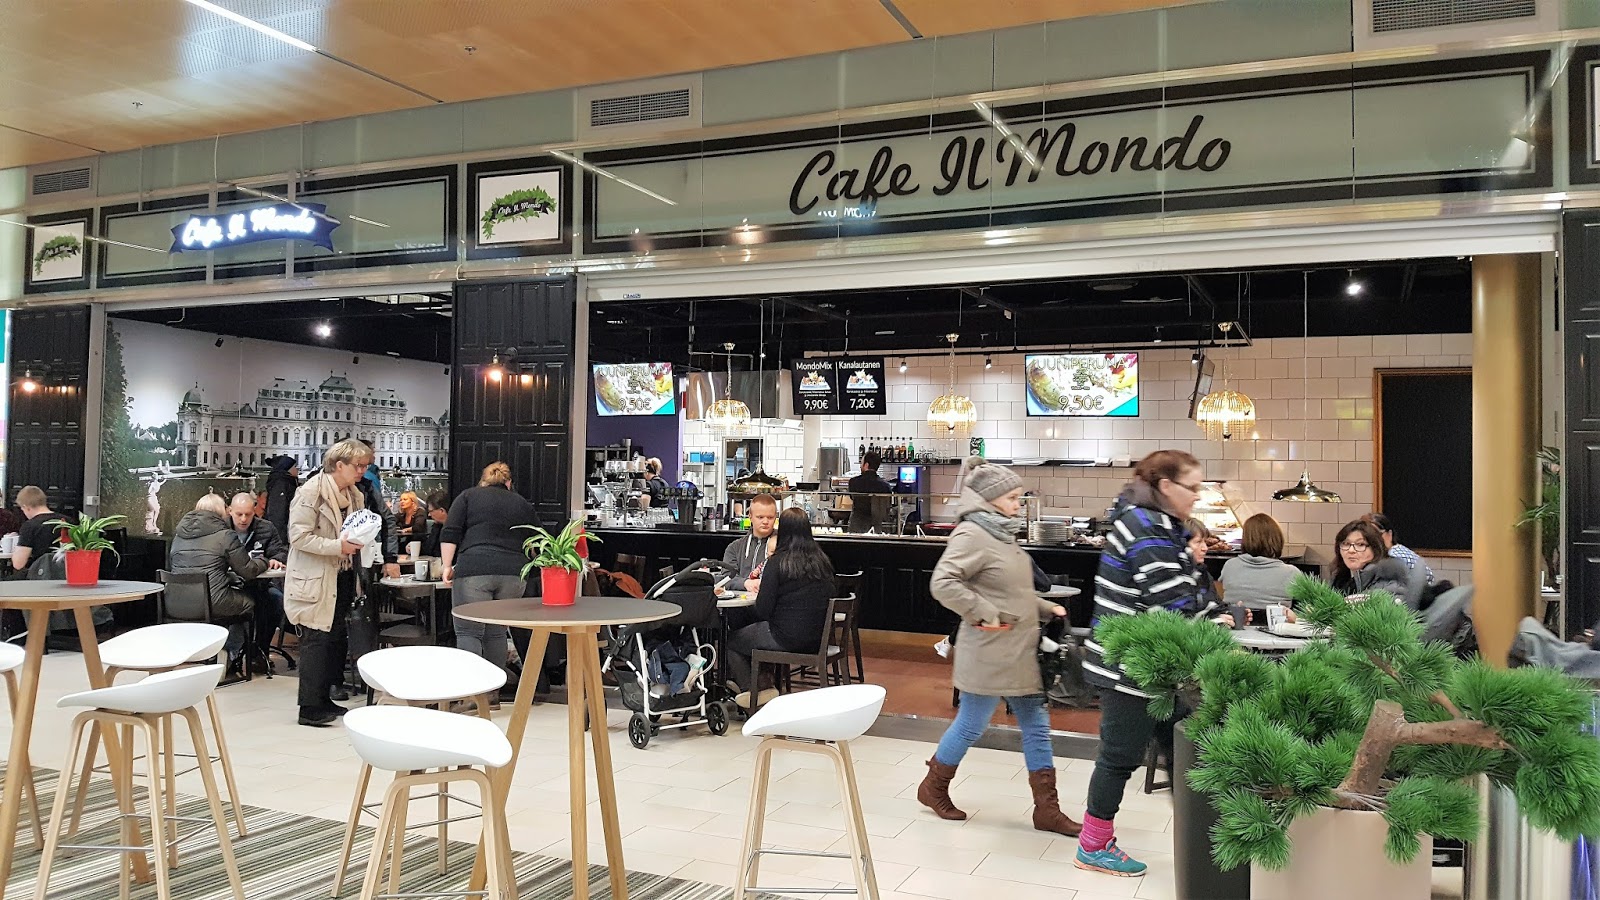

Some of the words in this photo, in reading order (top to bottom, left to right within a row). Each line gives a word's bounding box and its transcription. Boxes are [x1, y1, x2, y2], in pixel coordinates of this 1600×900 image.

[789, 145, 920, 217] Cafe
[932, 135, 990, 197] Il
[996, 114, 1232, 188] Mondo
[182, 211, 224, 248] Cafe
[250, 202, 317, 235] Mondo
[795, 361, 833, 371] MondoMix
[838, 360, 881, 370] Kanalautanen
[618, 397, 653, 413] 9,50€
[803, 399, 829, 411] 9,90€
[849, 398, 876, 411] 7,20€
[1058, 394, 1105, 413] 9,50€
